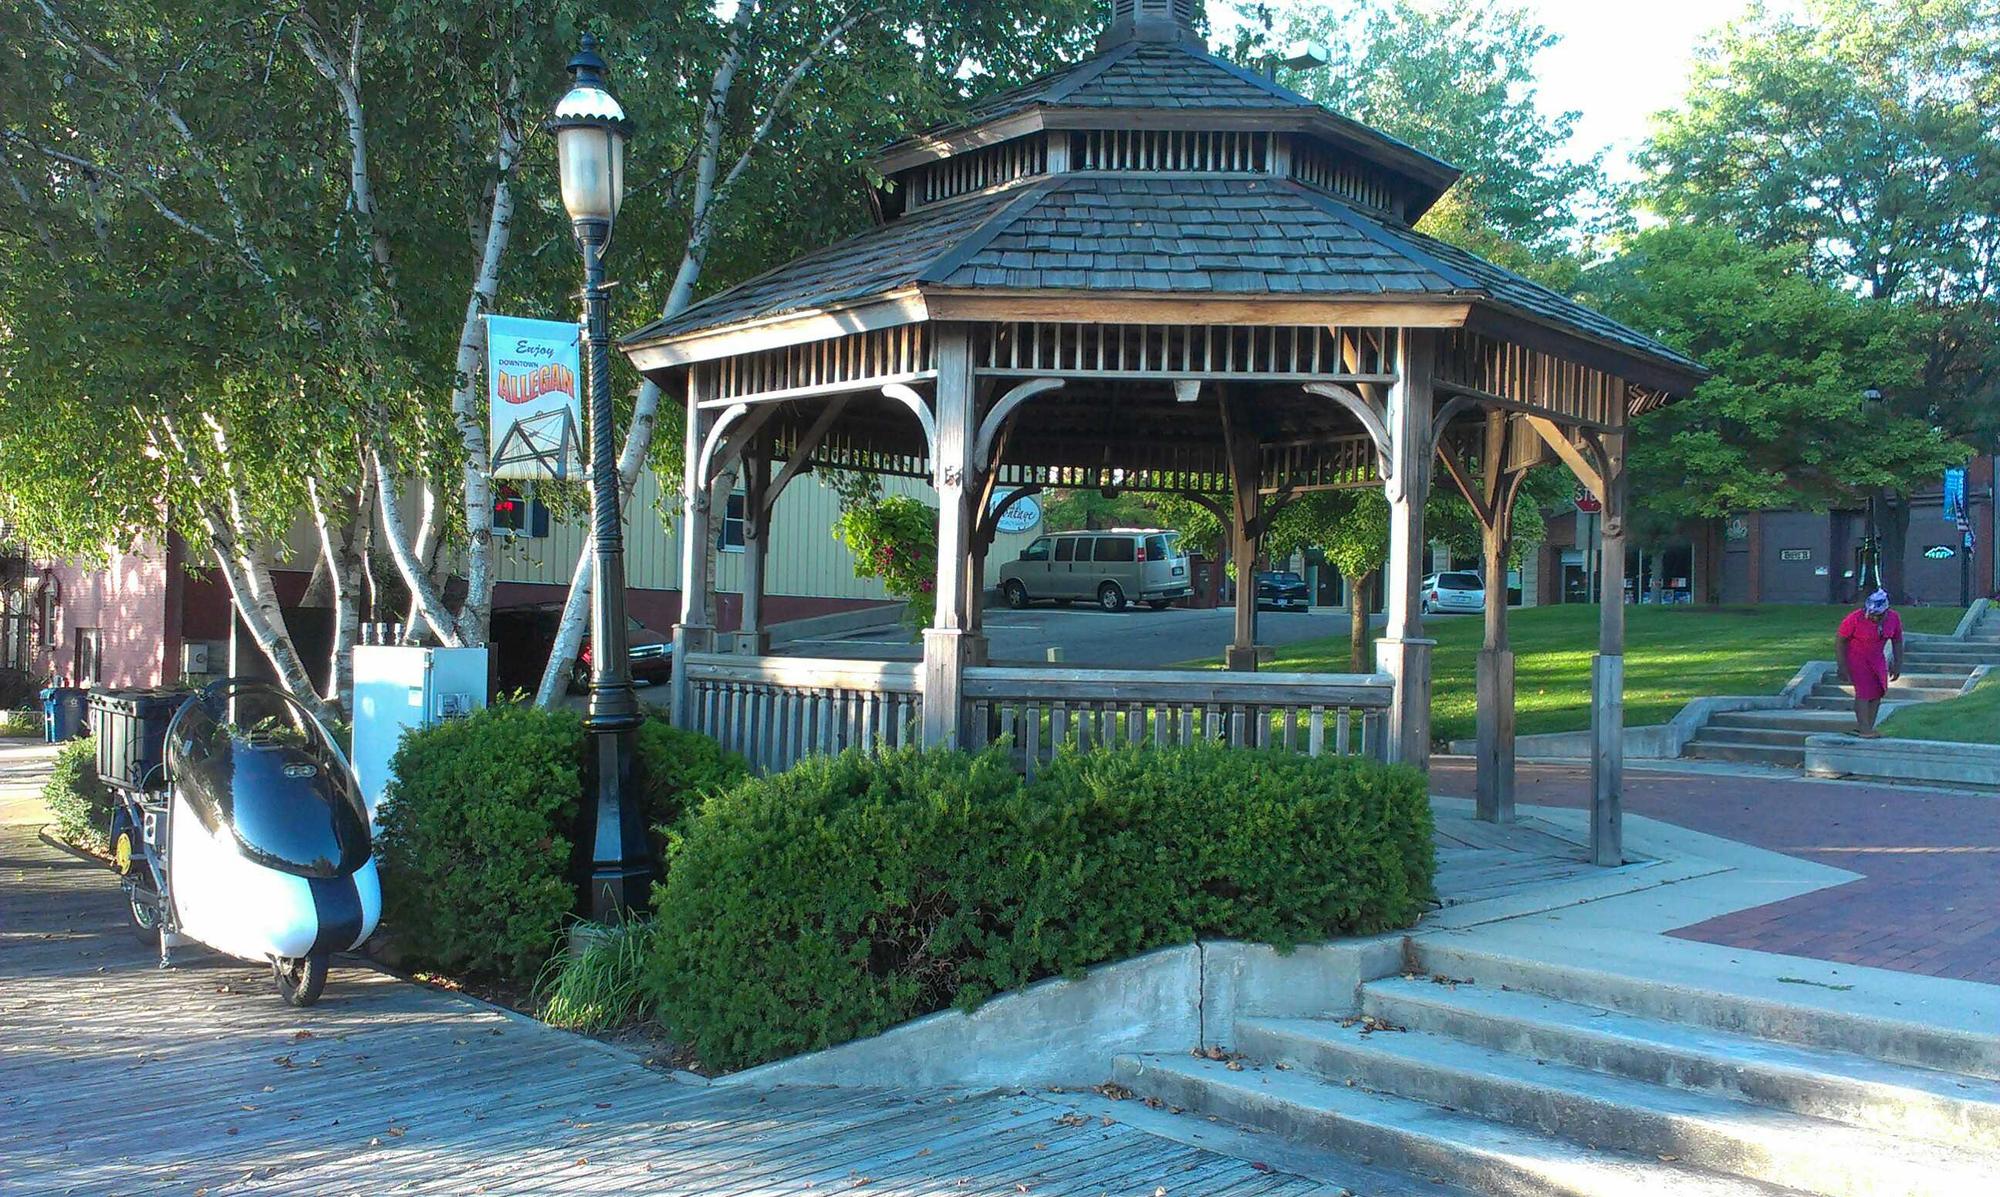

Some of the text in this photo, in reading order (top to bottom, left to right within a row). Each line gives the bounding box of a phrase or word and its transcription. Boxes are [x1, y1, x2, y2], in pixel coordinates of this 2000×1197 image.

[516, 340, 554, 358] Enjoy
[499, 359, 538, 368] DOWNTOWN
[498, 363, 574, 404] ALLEGAN
[1001, 508, 1035, 522] ontage
